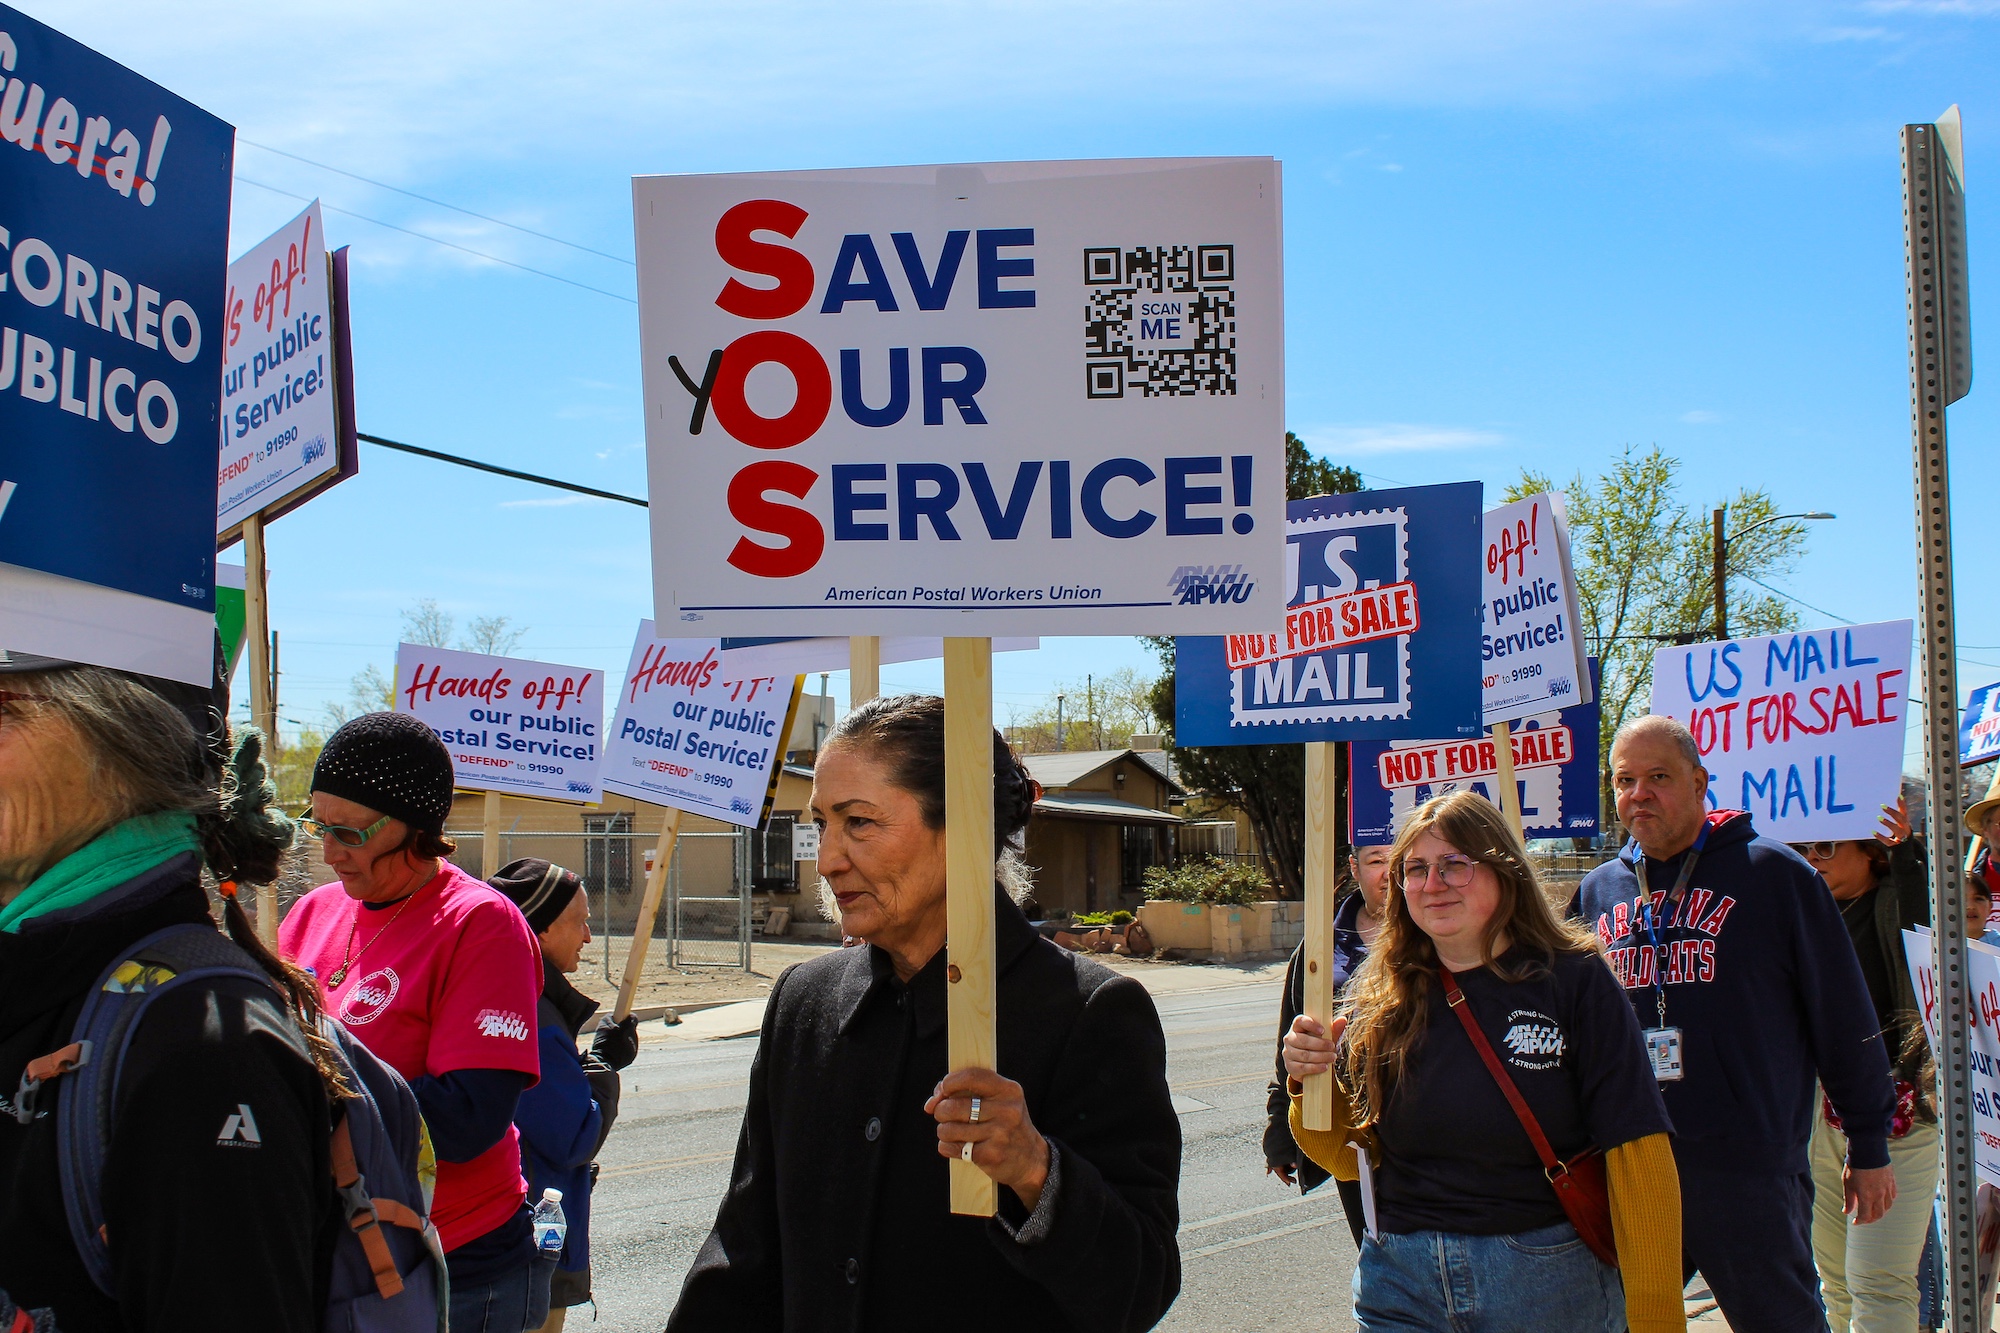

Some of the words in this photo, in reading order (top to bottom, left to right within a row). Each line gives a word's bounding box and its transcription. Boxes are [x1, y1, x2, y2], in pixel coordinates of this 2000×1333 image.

[253, 215, 311, 333] off!
[714, 199, 1036, 320] SAVE
[0, 226, 201, 363] ORREO
[1141, 303, 1181, 315] SCAN
[1140, 319, 1181, 340] ME
[222, 362, 246, 398] ur
[252, 311, 322, 388] public
[235, 354, 324, 438] Service!
[256, 450, 265, 463] to
[266, 425, 298, 457] 91990
[245, 478, 266, 498] Workers
[266, 469, 283, 484] Union
[726, 455, 1254, 577] SERVICE!
[1487, 502, 1538, 585] off!
[825, 586, 907, 601] American
[912, 586, 964, 601] Postal
[970, 587, 1043, 601] Workers
[1049, 585, 1102, 600] Union
[1172, 572, 1254, 605] APWU
[1492, 577, 1559, 625] public
[1286, 606, 1335, 650] FOR
[1340, 589, 1412, 638] SALE
[1482, 614, 1564, 661] Service!
[630, 643, 719, 704] Hands
[1253, 652, 1384, 705] MAIL
[1502, 675, 1510, 684] to
[1511, 663, 1542, 682] 91990
[1685, 642, 1742, 702] US
[1765, 629, 1879, 687] MAIL
[404, 663, 512, 710] Hands
[522, 673, 592, 711] off!
[1493, 697, 1514, 707] Workers
[1514, 693, 1530, 702] Union
[1805, 669, 1903, 735] SALE
[469, 708, 512, 725] our
[519, 714, 595, 737] public
[673, 701, 708, 723] our
[709, 708, 776, 738] public
[495, 732, 595, 761] Service!
[620, 718, 682, 751] Postal
[683, 731, 769, 771] Service!
[1385, 750, 1438, 784] NOT
[1444, 742, 1497, 775] FOR
[480, 773, 500, 781] Postal
[500, 776, 526, 784] Workers
[516, 763, 526, 771] to
[528, 763, 564, 775] 91990
[632, 757, 646, 768] Text
[694, 772, 702, 781] to
[703, 773, 733, 789] 91990
[1742, 754, 1855, 821] MAIL
[640, 780, 663, 790] American
[663, 785, 678, 794] Postal
[678, 788, 698, 799] Workers
[698, 793, 713, 802] Union
[476, 1013, 529, 1041] APWU
[1515, 1059, 1541, 1070] STRONG
